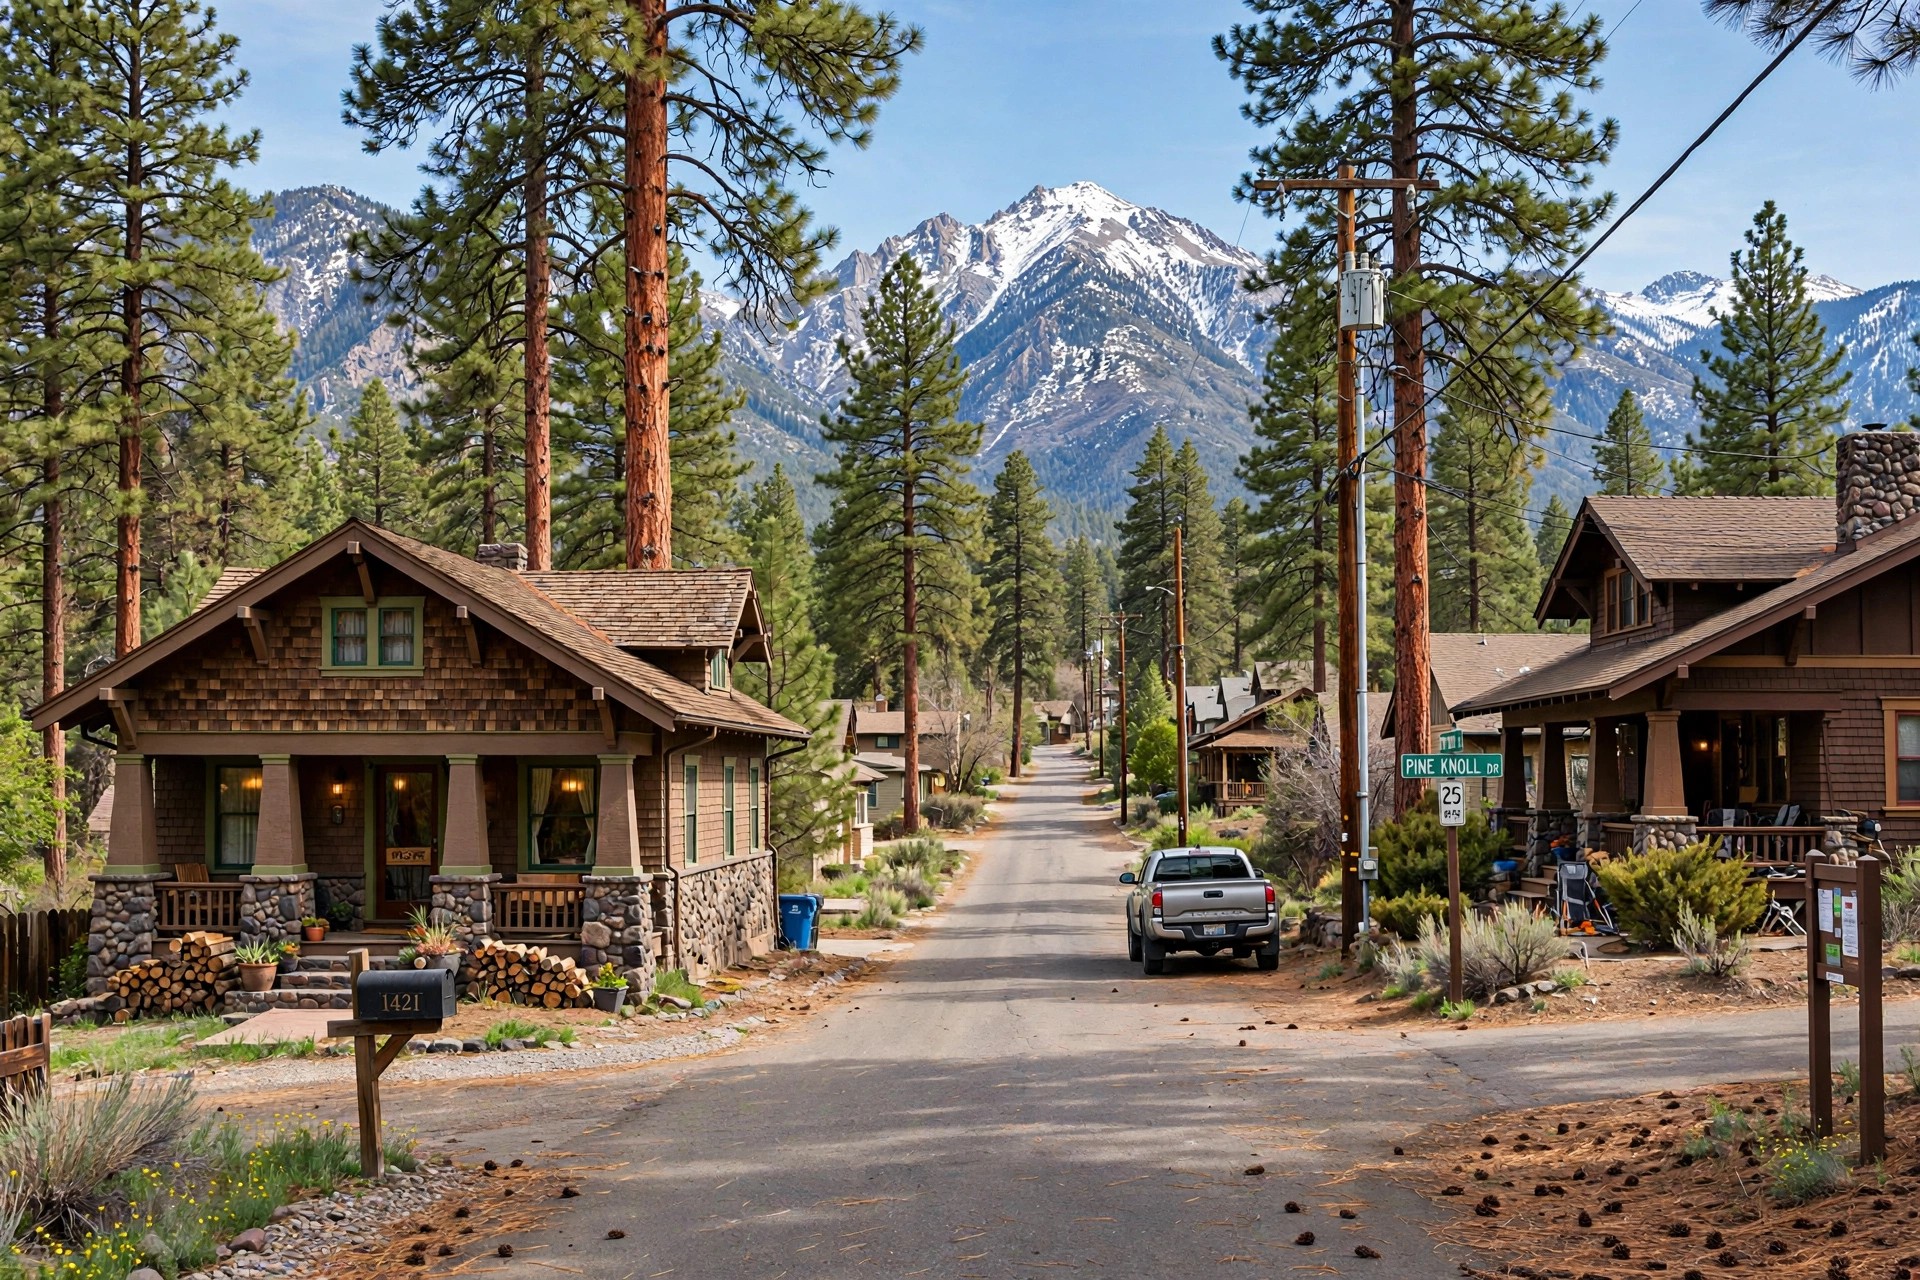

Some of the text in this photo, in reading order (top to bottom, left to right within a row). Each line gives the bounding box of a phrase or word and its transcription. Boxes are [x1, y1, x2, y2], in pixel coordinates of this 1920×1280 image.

[1406, 758, 1499, 775] PINE KNOLL DR
[1442, 786, 1461, 804] 25
[381, 993, 420, 1011] 1421
